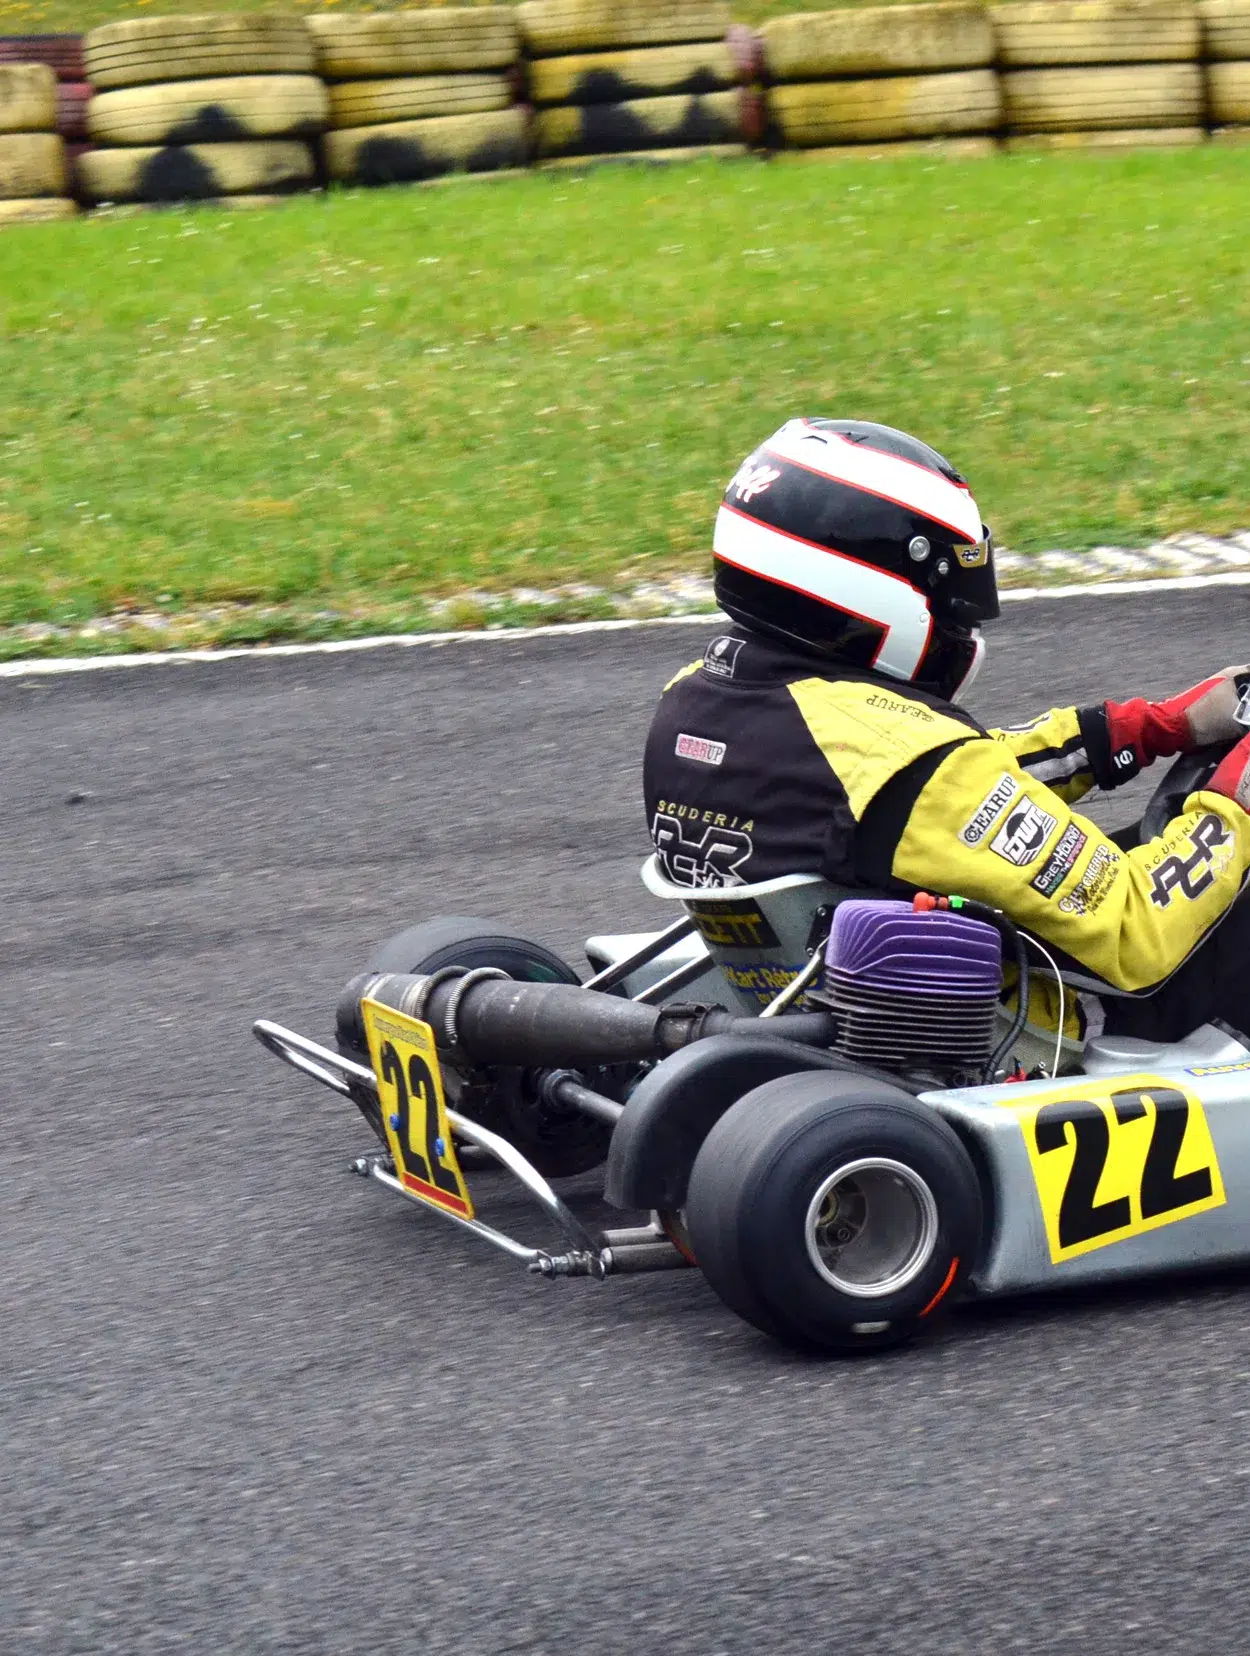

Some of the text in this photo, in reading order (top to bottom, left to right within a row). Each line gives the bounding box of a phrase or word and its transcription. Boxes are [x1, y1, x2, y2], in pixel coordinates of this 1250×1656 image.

[865, 693, 935, 726] GEARUP
[657, 799, 755, 833] SCUDERIA
[963, 774, 1018, 843] GEARUP
[1144, 809, 1203, 872] SCUDERIA
[380, 1040, 462, 1198] 22
[1034, 1086, 1214, 1250] 22
